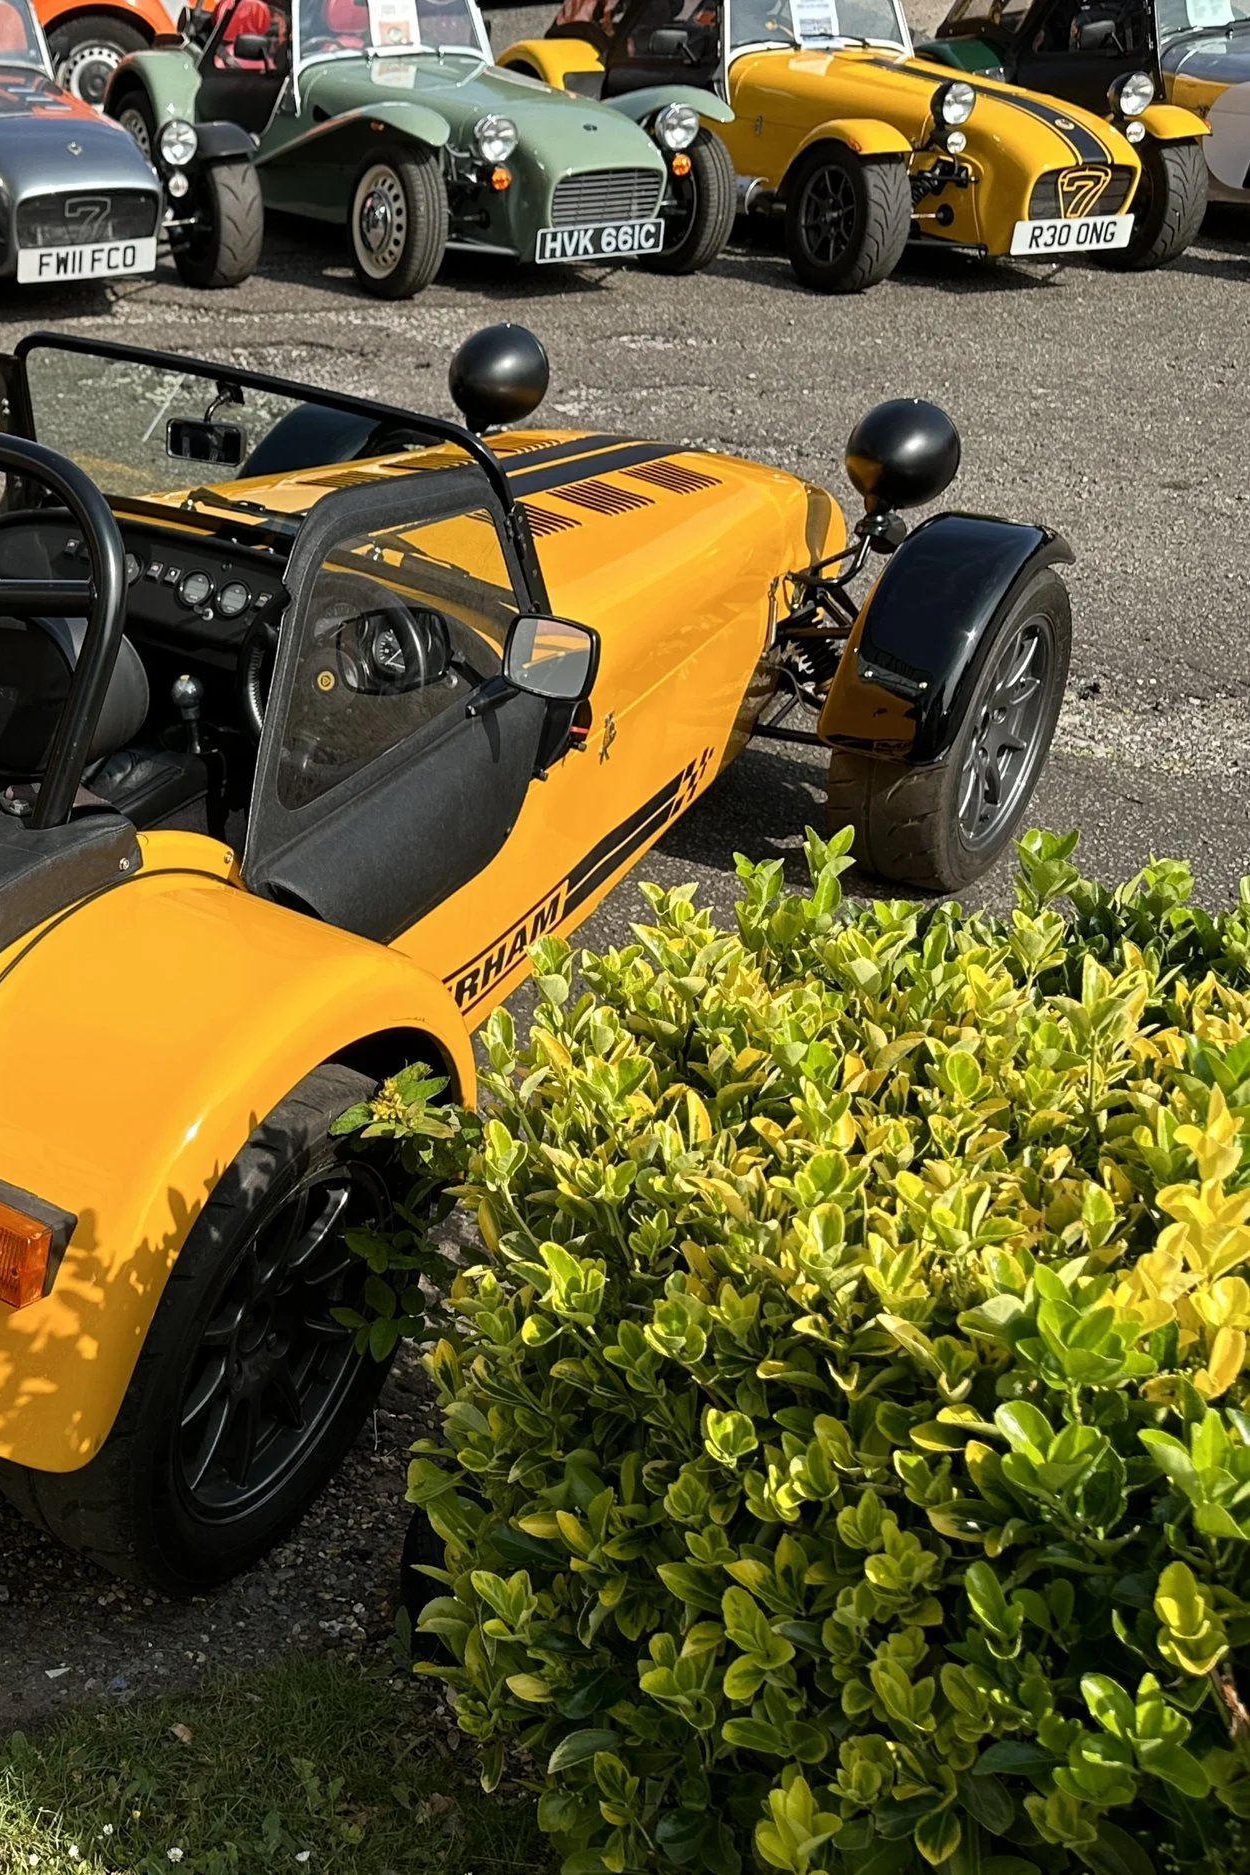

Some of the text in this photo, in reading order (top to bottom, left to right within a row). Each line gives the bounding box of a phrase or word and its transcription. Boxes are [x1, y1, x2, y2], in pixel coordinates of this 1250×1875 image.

[65, 196, 112, 243] 7
[1028, 221, 1118, 249] R30 ONG
[545, 223, 656, 258] HVK 661C
[38, 245, 136, 276] FW11 FCO
[447, 891, 561, 1008] RHAM
